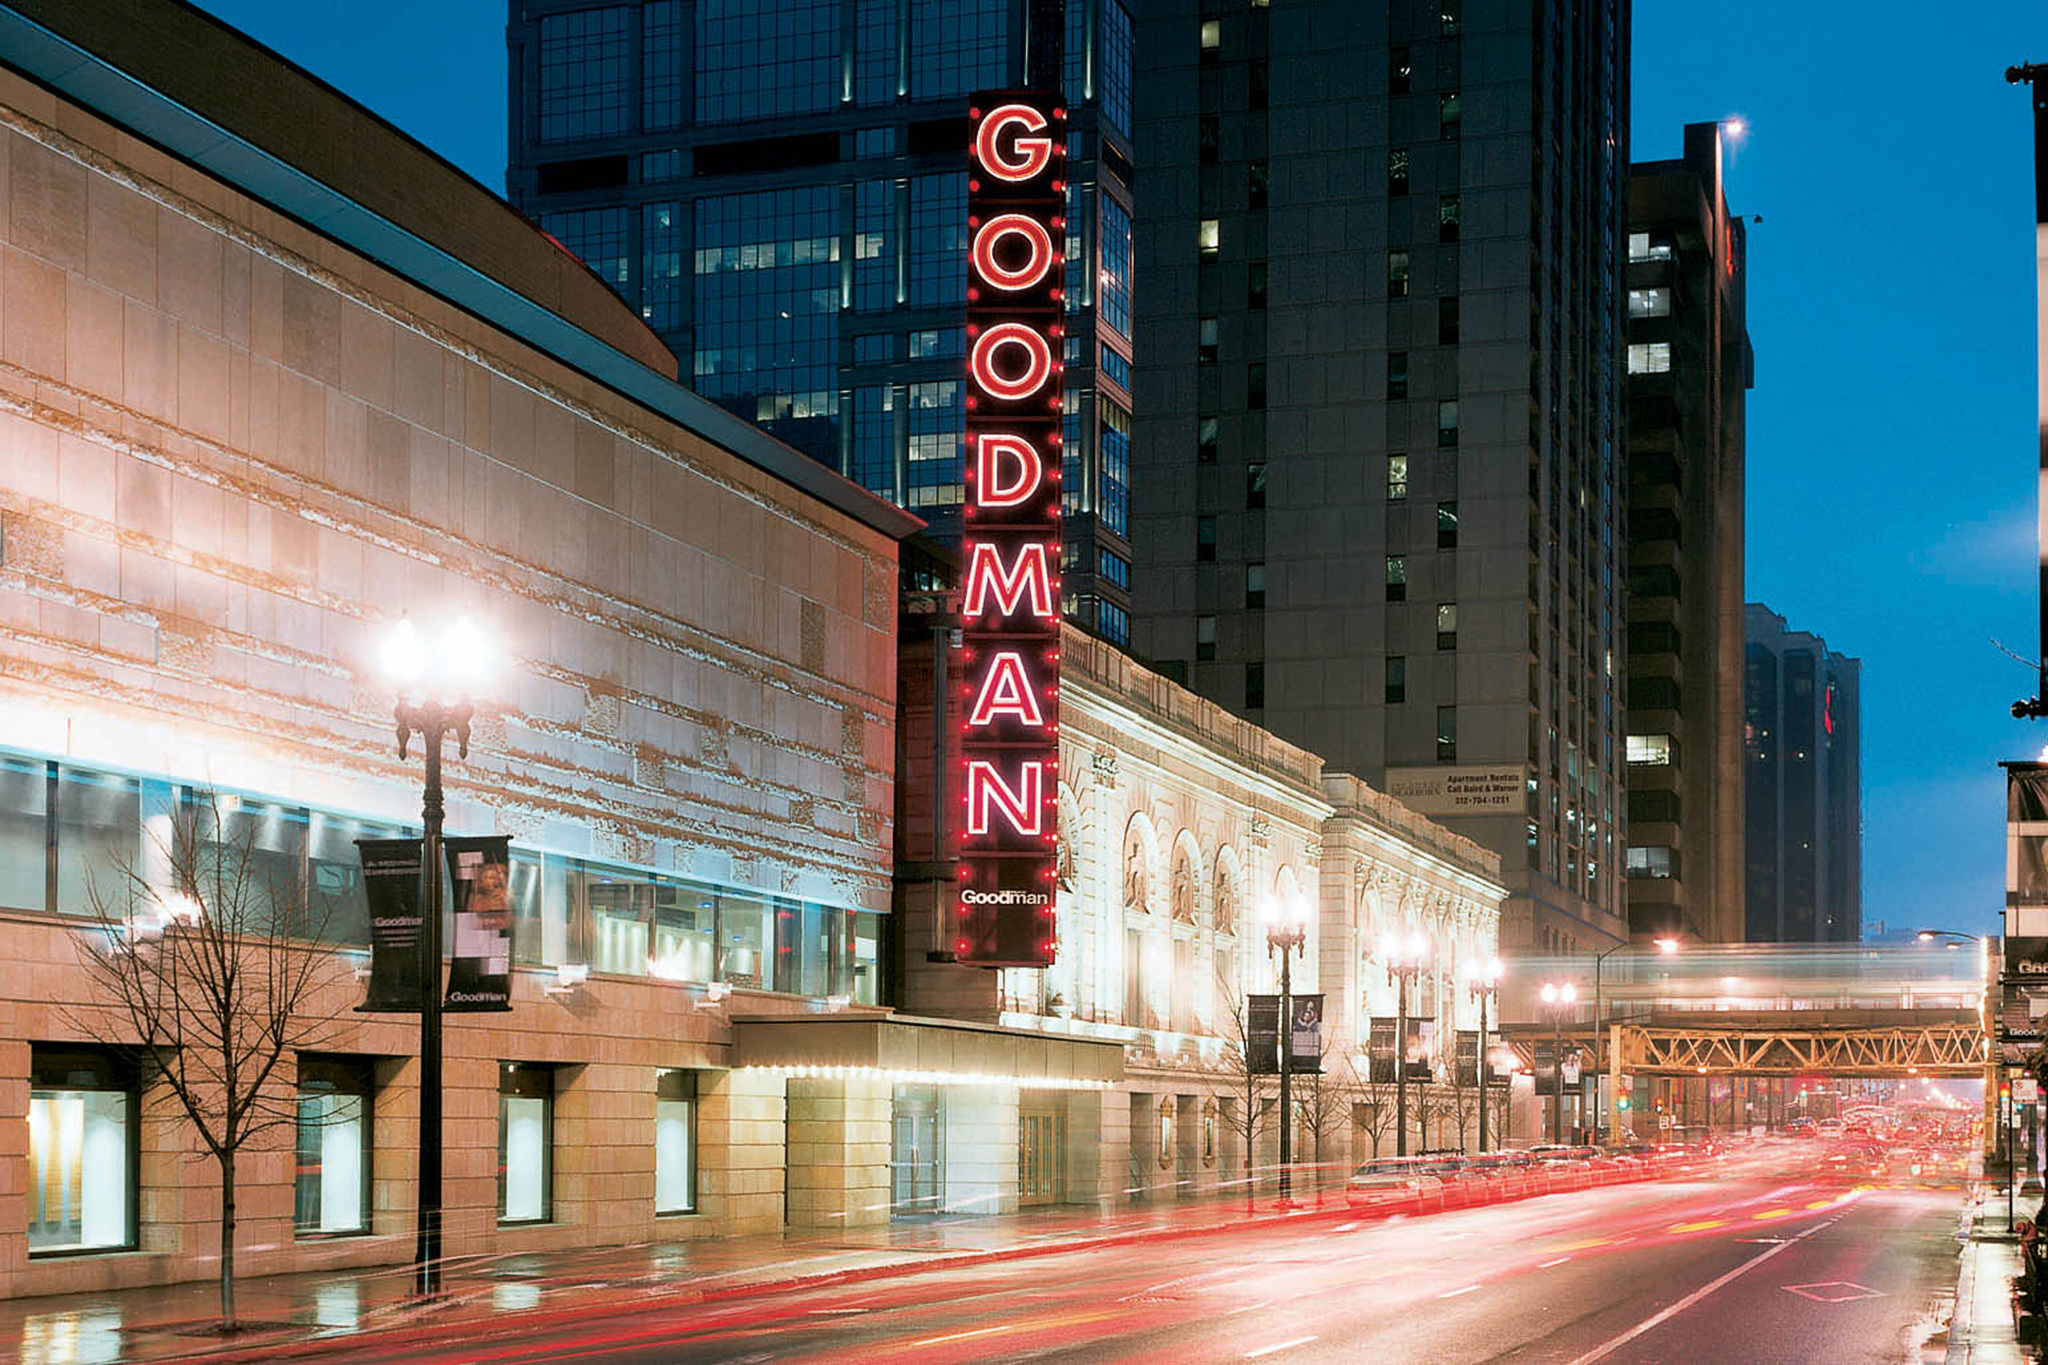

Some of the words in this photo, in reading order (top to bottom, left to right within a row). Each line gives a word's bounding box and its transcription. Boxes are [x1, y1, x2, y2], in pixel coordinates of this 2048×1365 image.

[962, 102, 1053, 838] GOODMAN
[1447, 775, 1487, 783] Apartment
[1447, 784, 1461, 793] Call
[961, 889, 1048, 905] Goodman
[450, 991, 507, 1002] Goodman
